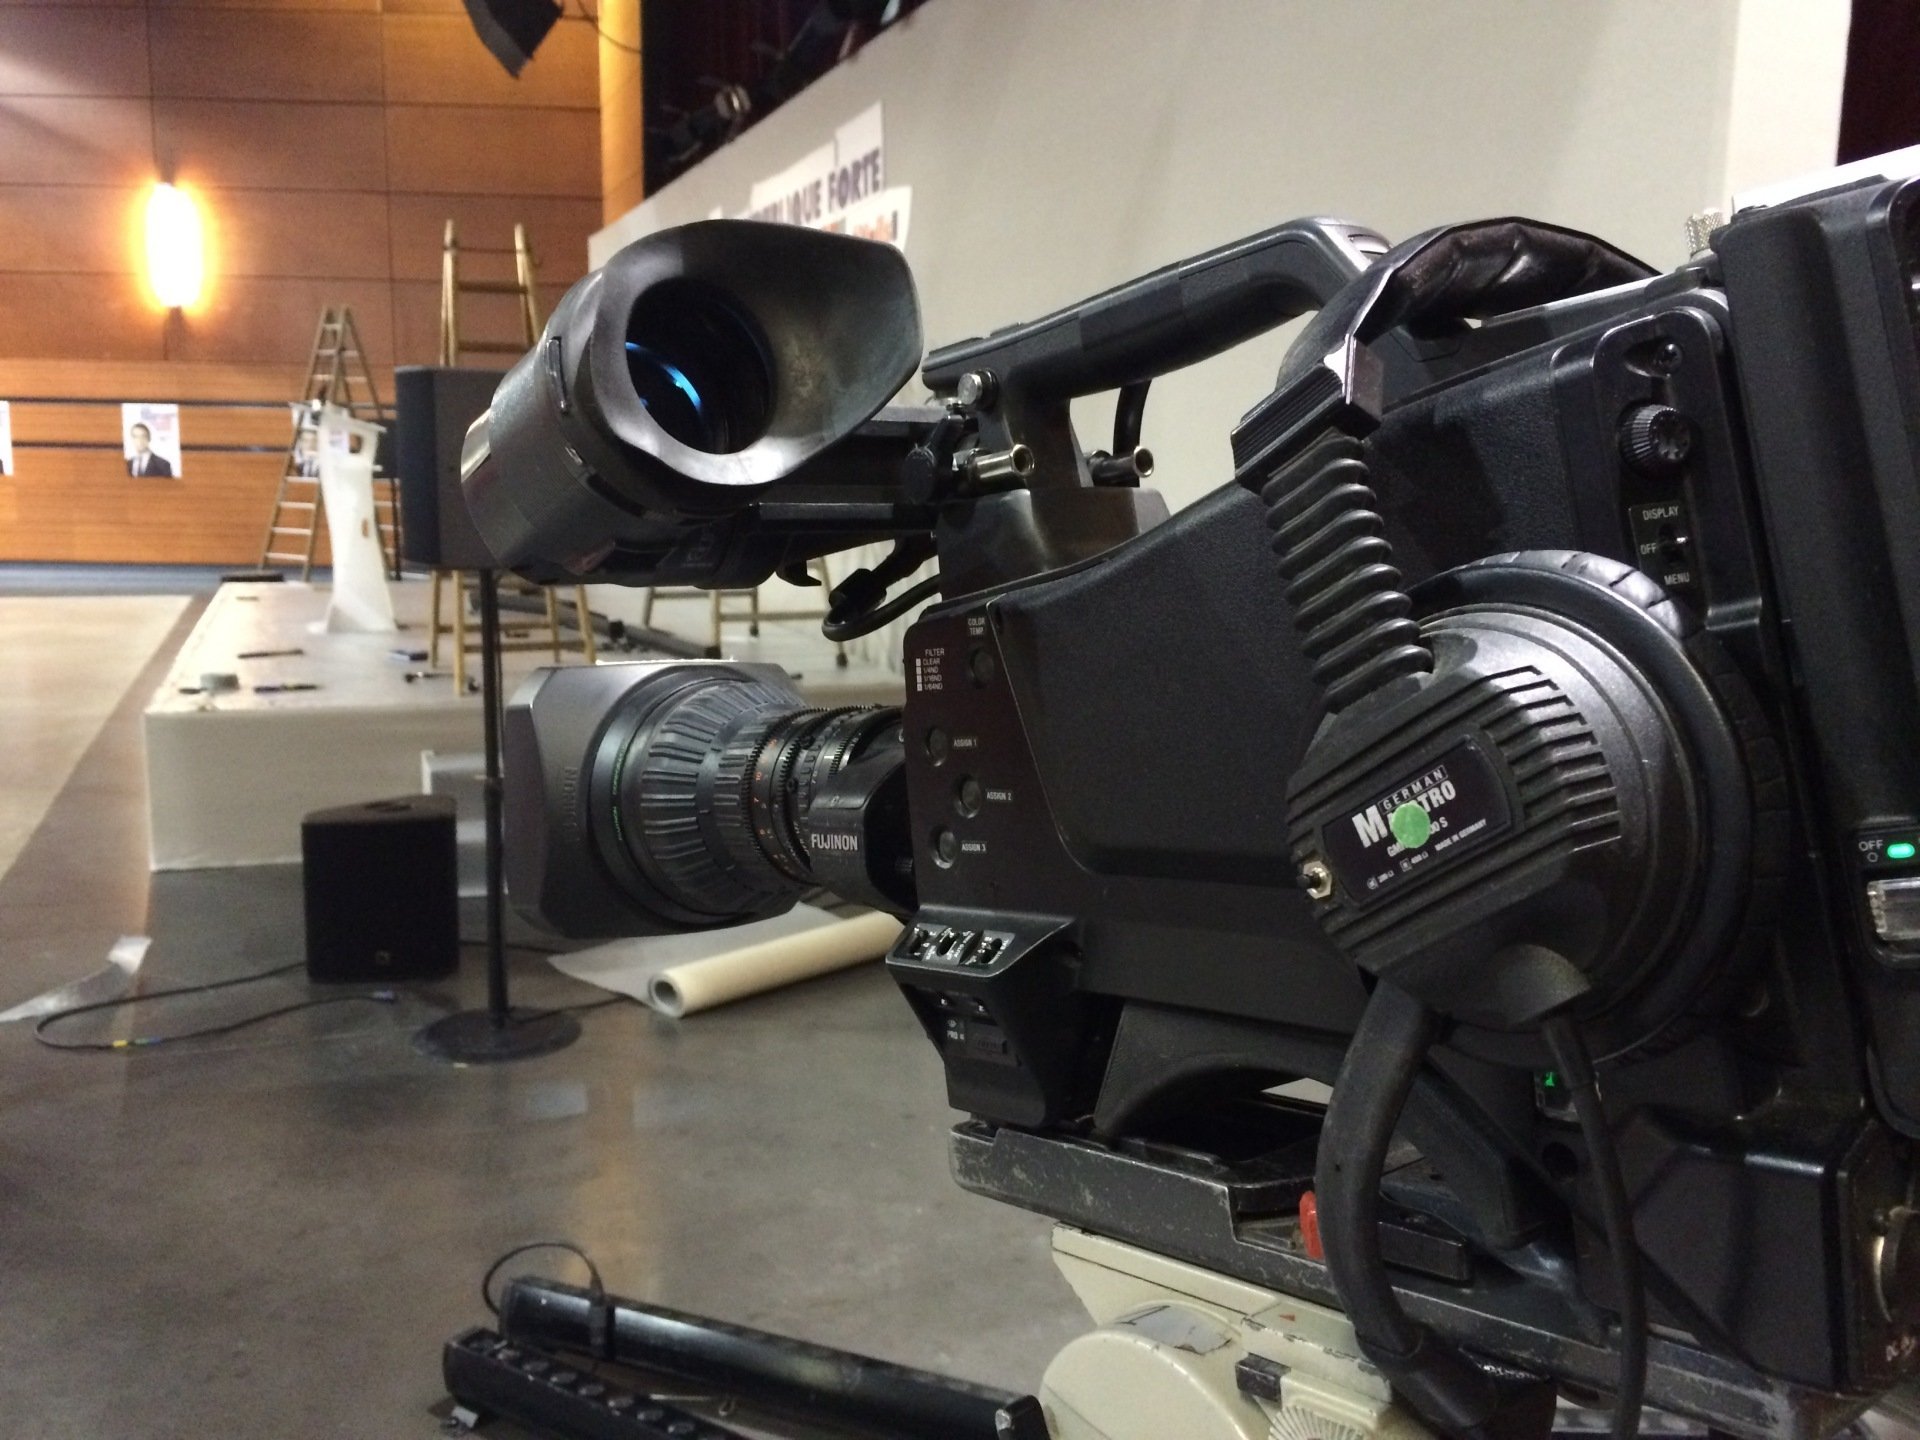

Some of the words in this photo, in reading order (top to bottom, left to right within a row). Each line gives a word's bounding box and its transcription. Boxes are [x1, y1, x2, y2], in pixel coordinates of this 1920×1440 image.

[828, 148, 880, 213] FORTE
[1642, 505, 1680, 521] DISPLAY
[1640, 542, 1657, 555] OFF
[1663, 571, 1690, 585] MENU
[967, 617, 986, 626] COLOR
[925, 648, 945, 656] FILTER
[922, 658, 941, 666] CLEAR
[953, 738, 973, 748] ASSIGN
[986, 791, 1006, 801] ASSIGN
[1382, 769, 1444, 810] GERMAN
[1352, 780, 1457, 848] MTRO
[811, 833, 858, 851] FUJINON
[961, 843, 981, 852] ASSIGN
[1858, 839, 1884, 852] OFF
